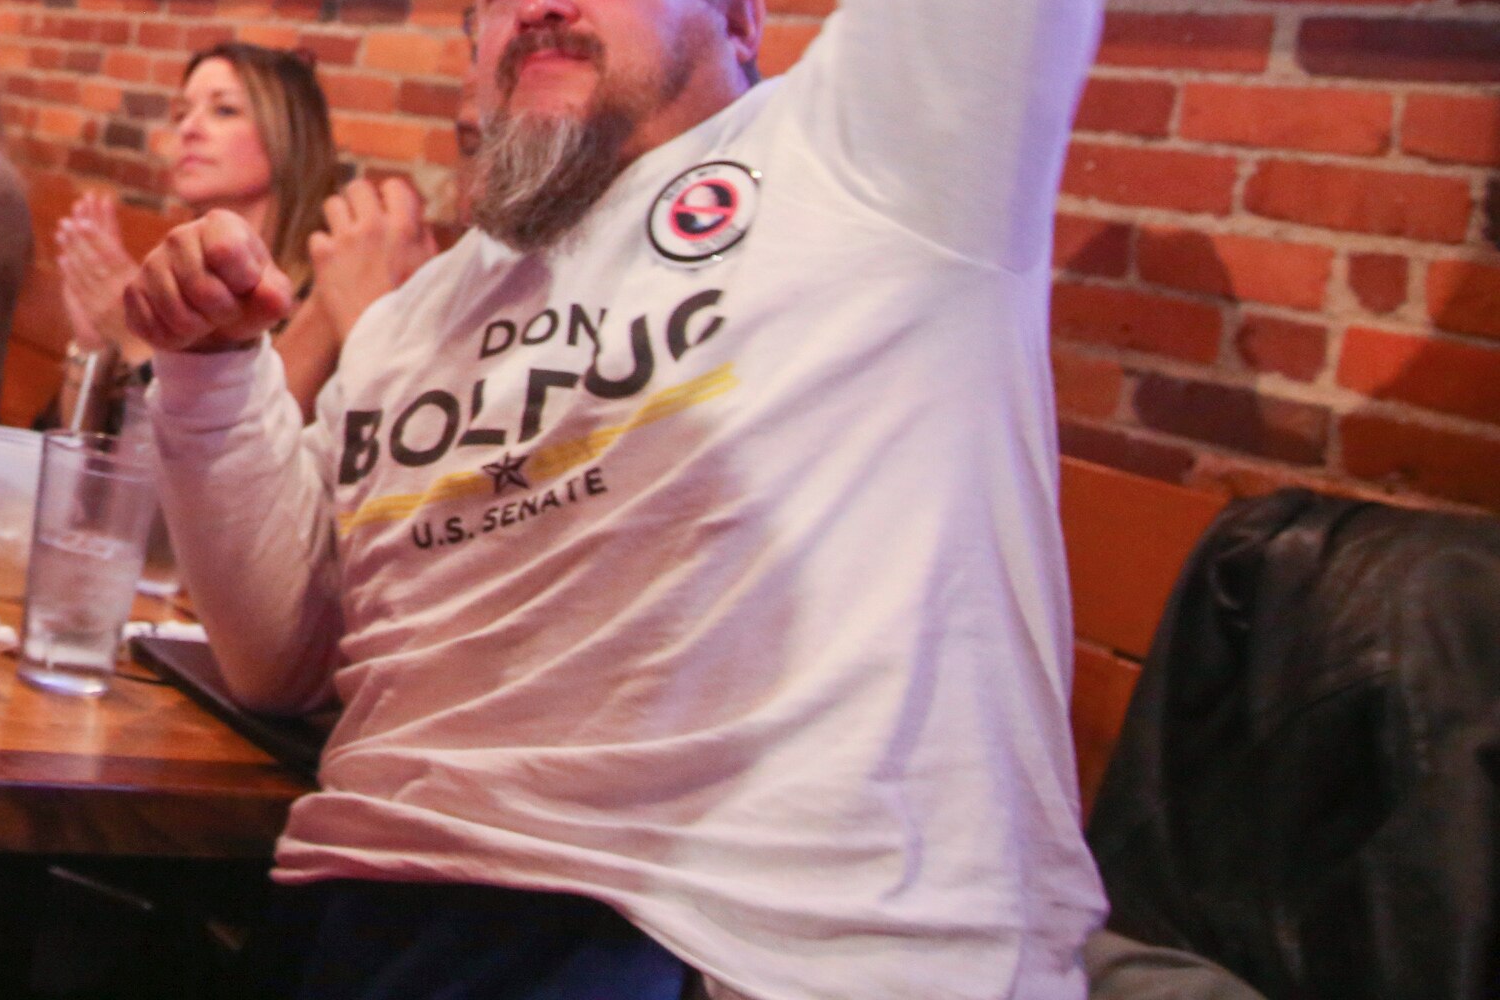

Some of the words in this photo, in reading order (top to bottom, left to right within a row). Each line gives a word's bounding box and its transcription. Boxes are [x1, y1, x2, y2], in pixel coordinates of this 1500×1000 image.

[478, 303, 609, 360] DON
[411, 513, 475, 550] U.S.
[482, 466, 610, 534] SENATE
